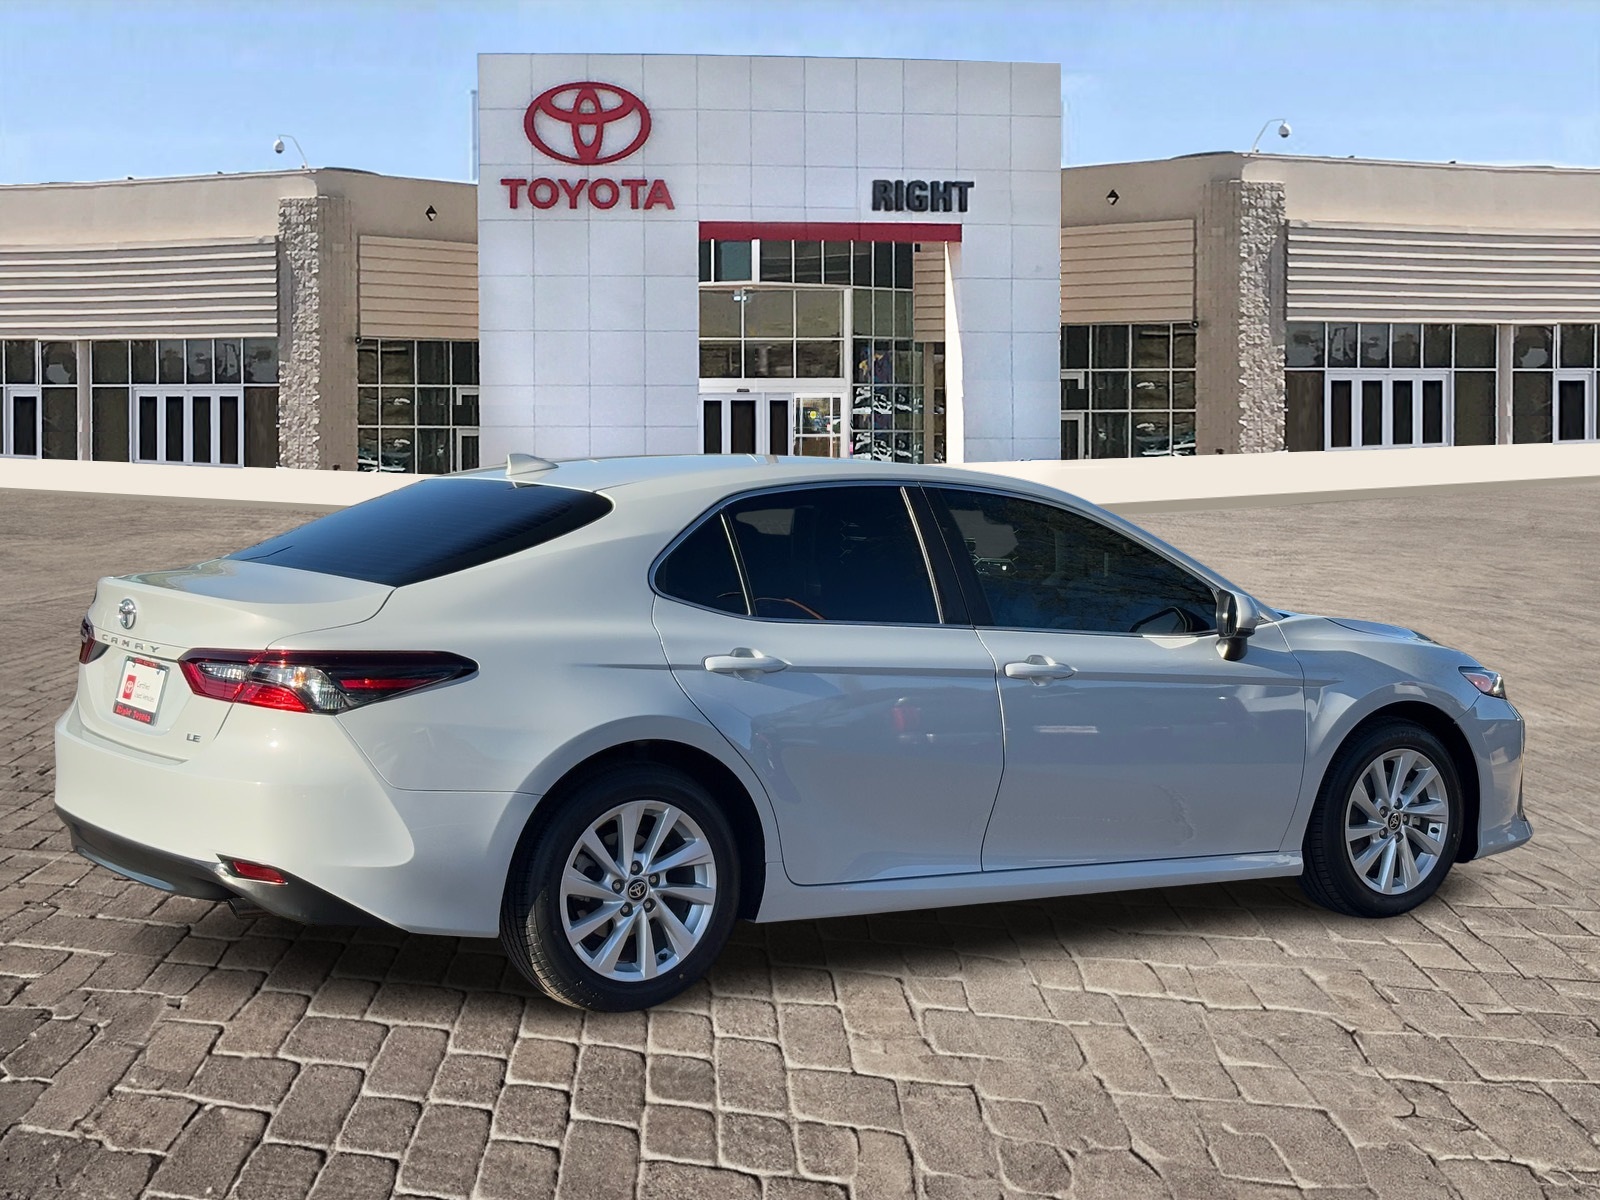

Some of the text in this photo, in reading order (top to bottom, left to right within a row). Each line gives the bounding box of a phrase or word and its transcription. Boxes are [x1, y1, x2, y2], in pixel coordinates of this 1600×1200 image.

[500, 178, 675, 210] TOYOTA
[872, 180, 975, 212] RIGHT
[101, 633, 160, 653] CAMRY
[186, 733, 202, 743] LE
